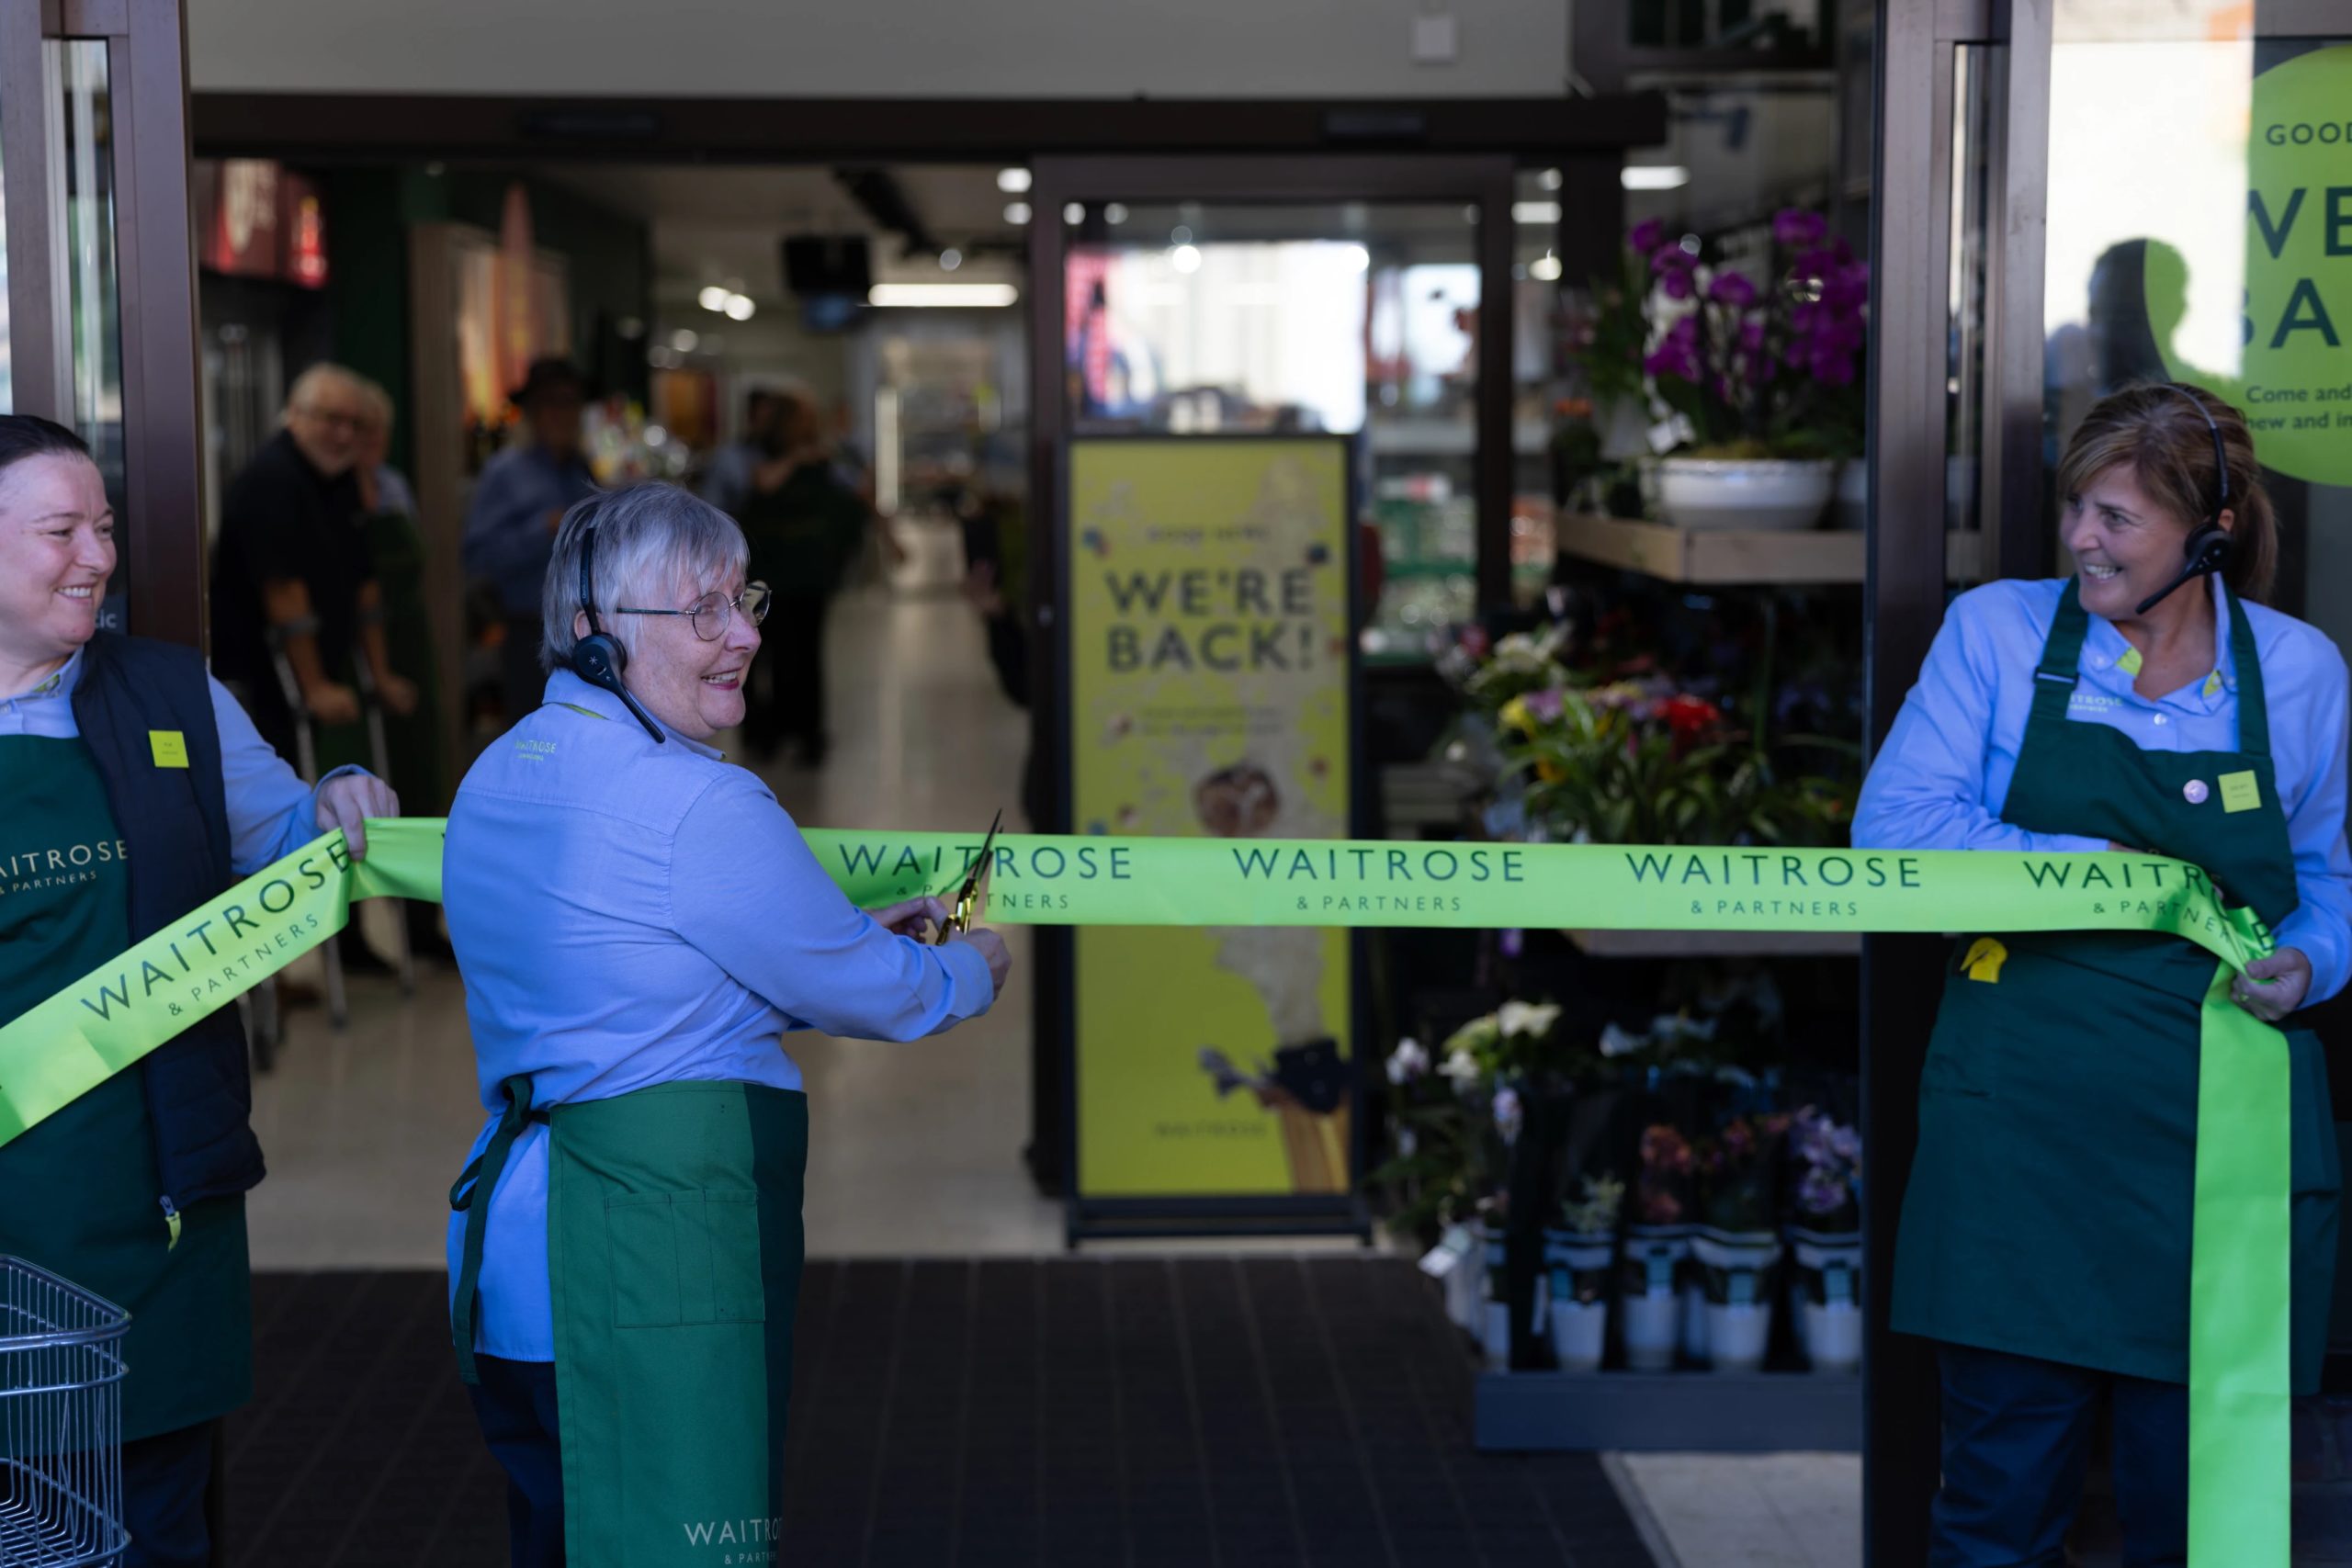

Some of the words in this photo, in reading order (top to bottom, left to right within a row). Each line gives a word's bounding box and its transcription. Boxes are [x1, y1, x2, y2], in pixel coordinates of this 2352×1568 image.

[2245, 385, 2308, 404] Come
[2315, 382, 2352, 402] and
[2292, 412, 2329, 430] and
[1104, 566, 1314, 617] WE'RE
[1106, 622, 1315, 673] BACK!
[839, 843, 1132, 879] WAITROSE
[1232, 848, 1525, 883] WAITROSE
[1624, 852, 1921, 888] WAITROSE
[12, 870, 97, 893] PARTNERS
[896, 886, 908, 897] &
[1296, 896, 1308, 911] &
[1323, 896, 1463, 912] PARTNERS
[1690, 899, 1702, 915] &
[1717, 899, 1858, 917] PARTNERS
[2093, 901, 2106, 914] &
[80, 838, 351, 1022] WAITROSE
[167, 1002, 184, 1017] &
[190, 913, 320, 1002] PARTNERS
[724, 1554, 732, 1565] &
